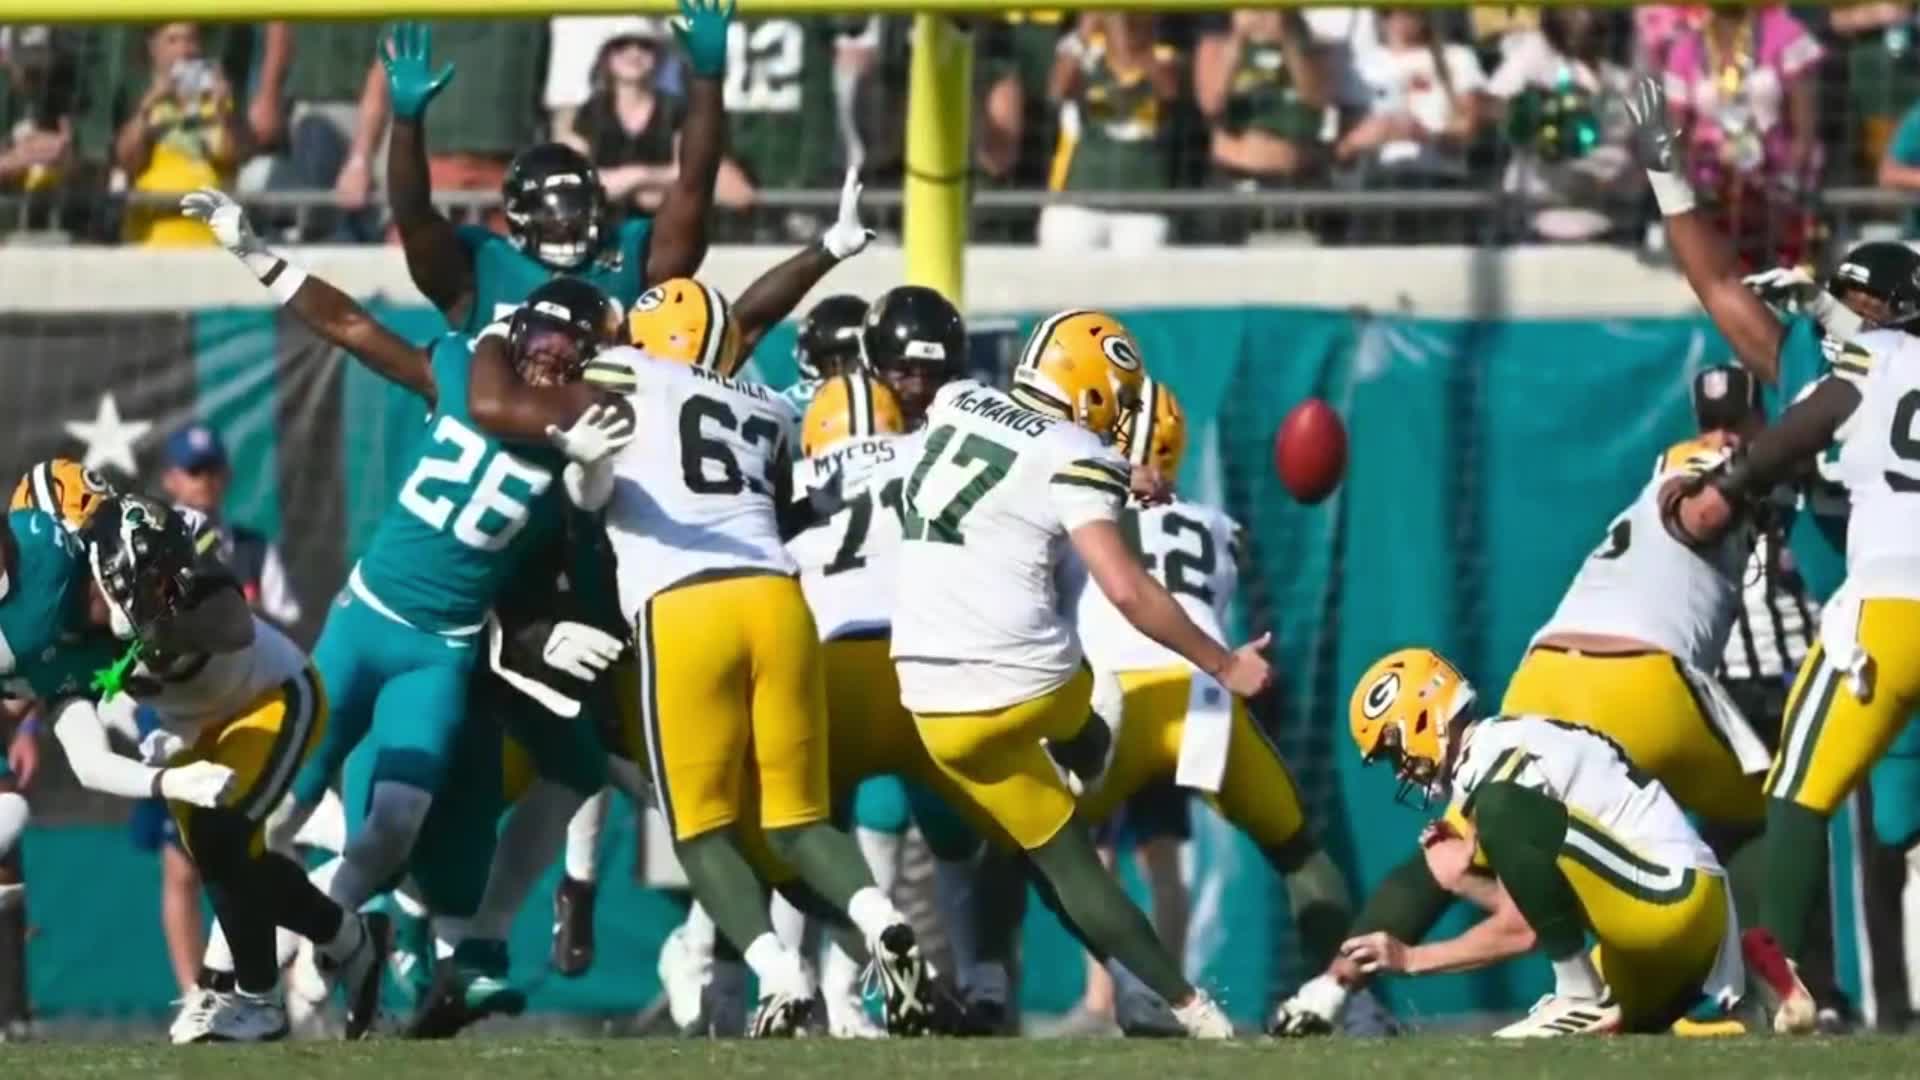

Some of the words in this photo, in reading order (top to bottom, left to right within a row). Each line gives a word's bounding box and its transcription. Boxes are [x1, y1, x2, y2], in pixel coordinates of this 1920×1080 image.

[723, 20, 802, 111] 12
[949, 389, 1056, 437] McMANUS
[398, 415, 553, 550] 26
[901, 424, 1019, 546] 17
